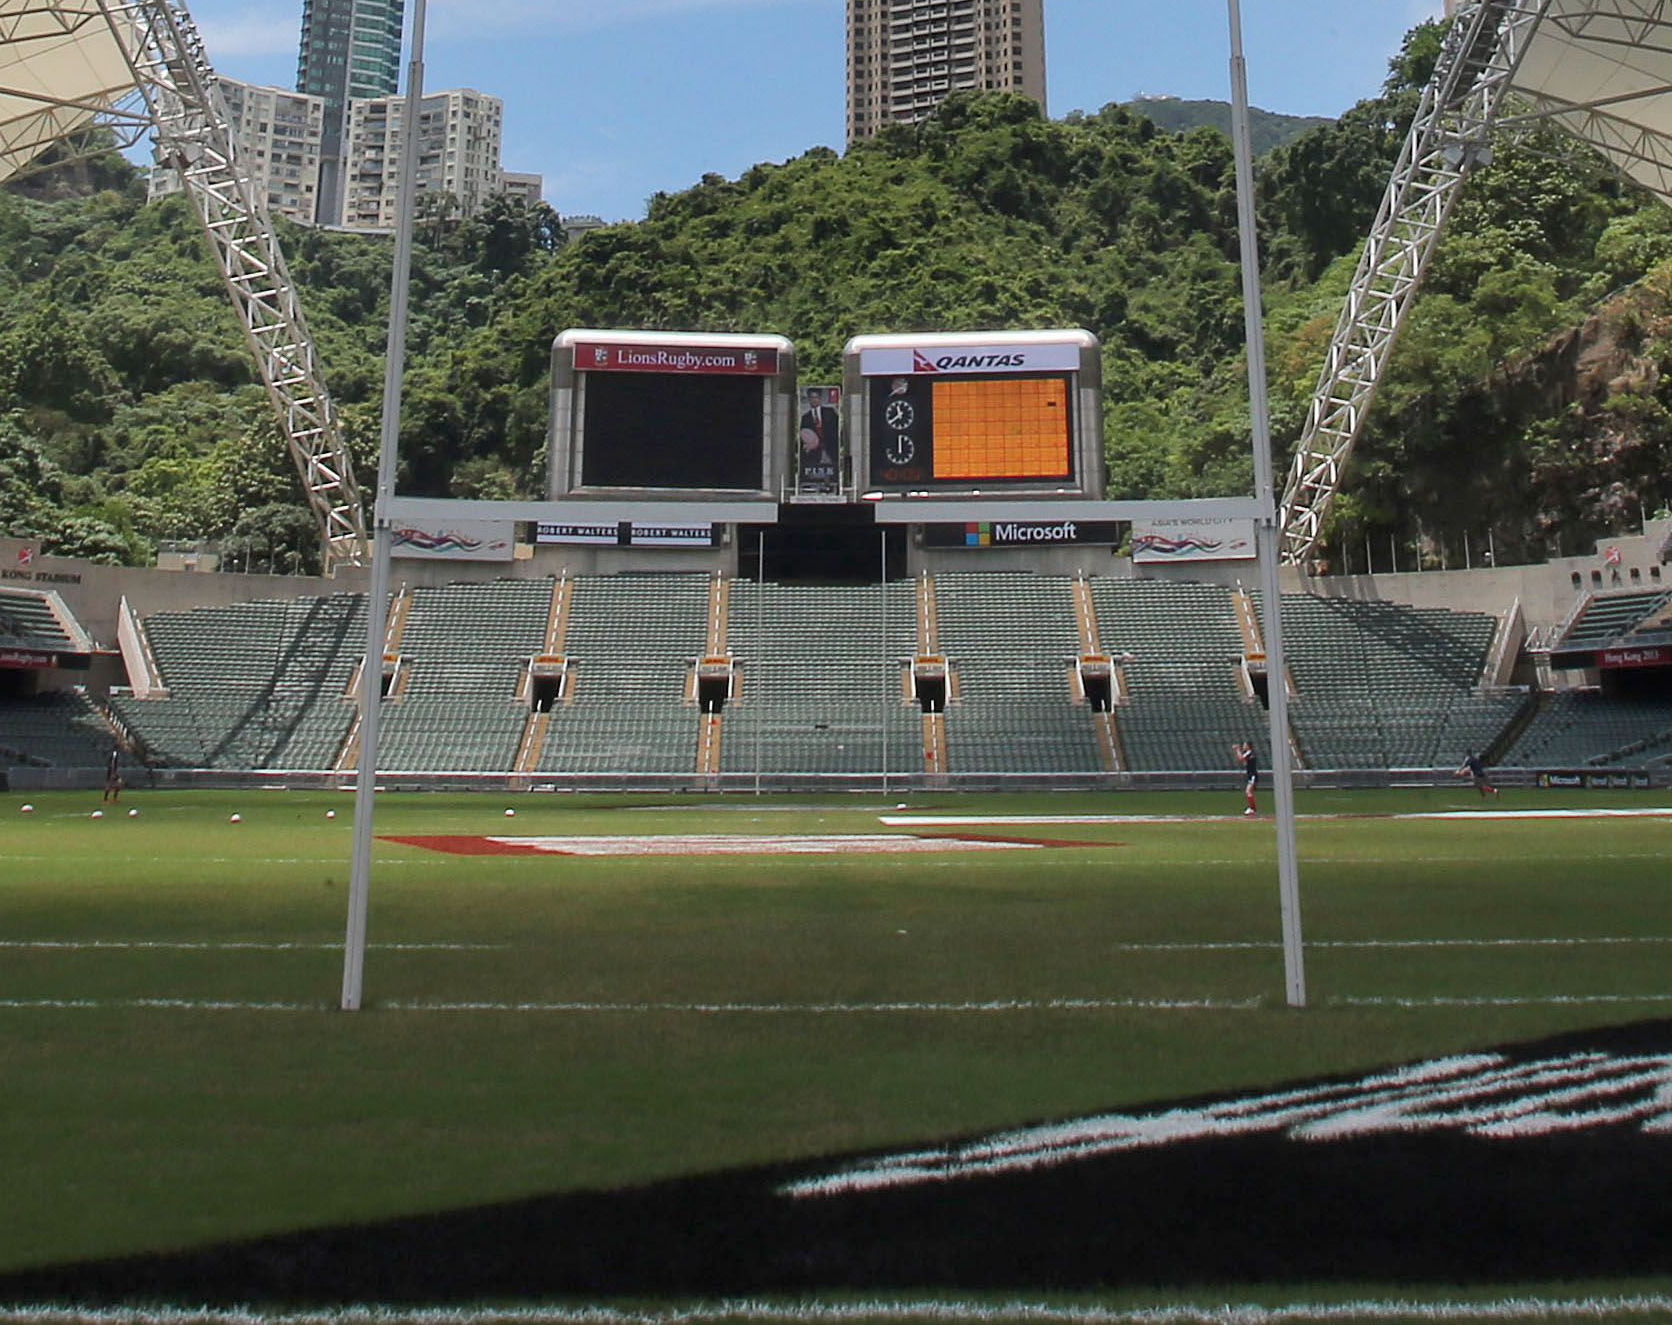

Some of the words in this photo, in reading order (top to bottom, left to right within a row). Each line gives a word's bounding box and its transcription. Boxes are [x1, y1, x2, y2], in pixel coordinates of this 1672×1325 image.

[617, 349, 736, 369] LionsRugby.com
[935, 353, 1026, 370] QANTAS
[537, 526, 574, 536] ROBERT
[577, 526, 618, 537] WALTERS
[631, 528, 668, 537] ROBERT
[670, 527, 712, 538] WALTERS
[994, 521, 1077, 542] Microsoft
